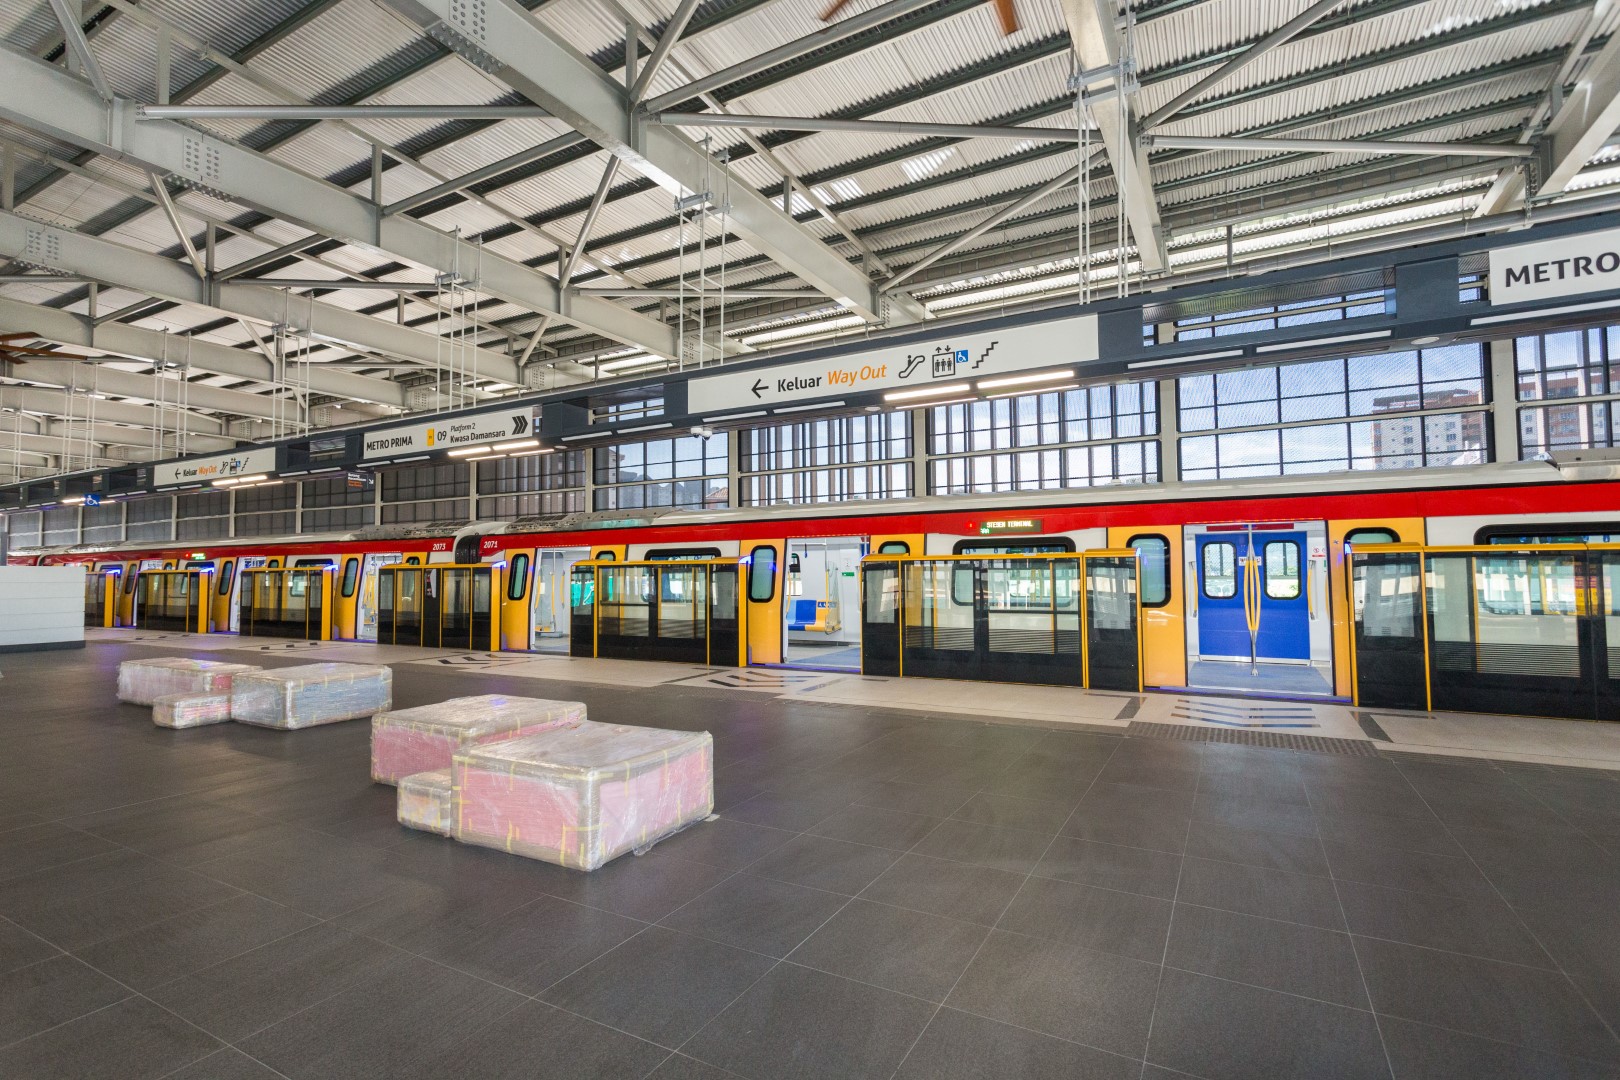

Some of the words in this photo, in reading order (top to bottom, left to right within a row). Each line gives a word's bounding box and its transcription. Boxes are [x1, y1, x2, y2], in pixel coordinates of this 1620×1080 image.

[1505, 252, 1620, 288] METRO
[777, 376, 822, 393] Keluar
[827, 370, 858, 387] Way
[860, 364, 887, 381] Out
[450, 424, 471, 433] Platform
[472, 422, 476, 430] 2
[437, 430, 447, 441] 09
[450, 434, 470, 444] Kwasa
[470, 430, 506, 441] Damansara
[366, 440, 390, 452] METRO
[391, 436, 413, 448] PRIMA
[183, 468, 198, 477] Keluar
[483, 540, 498, 549] 2071
